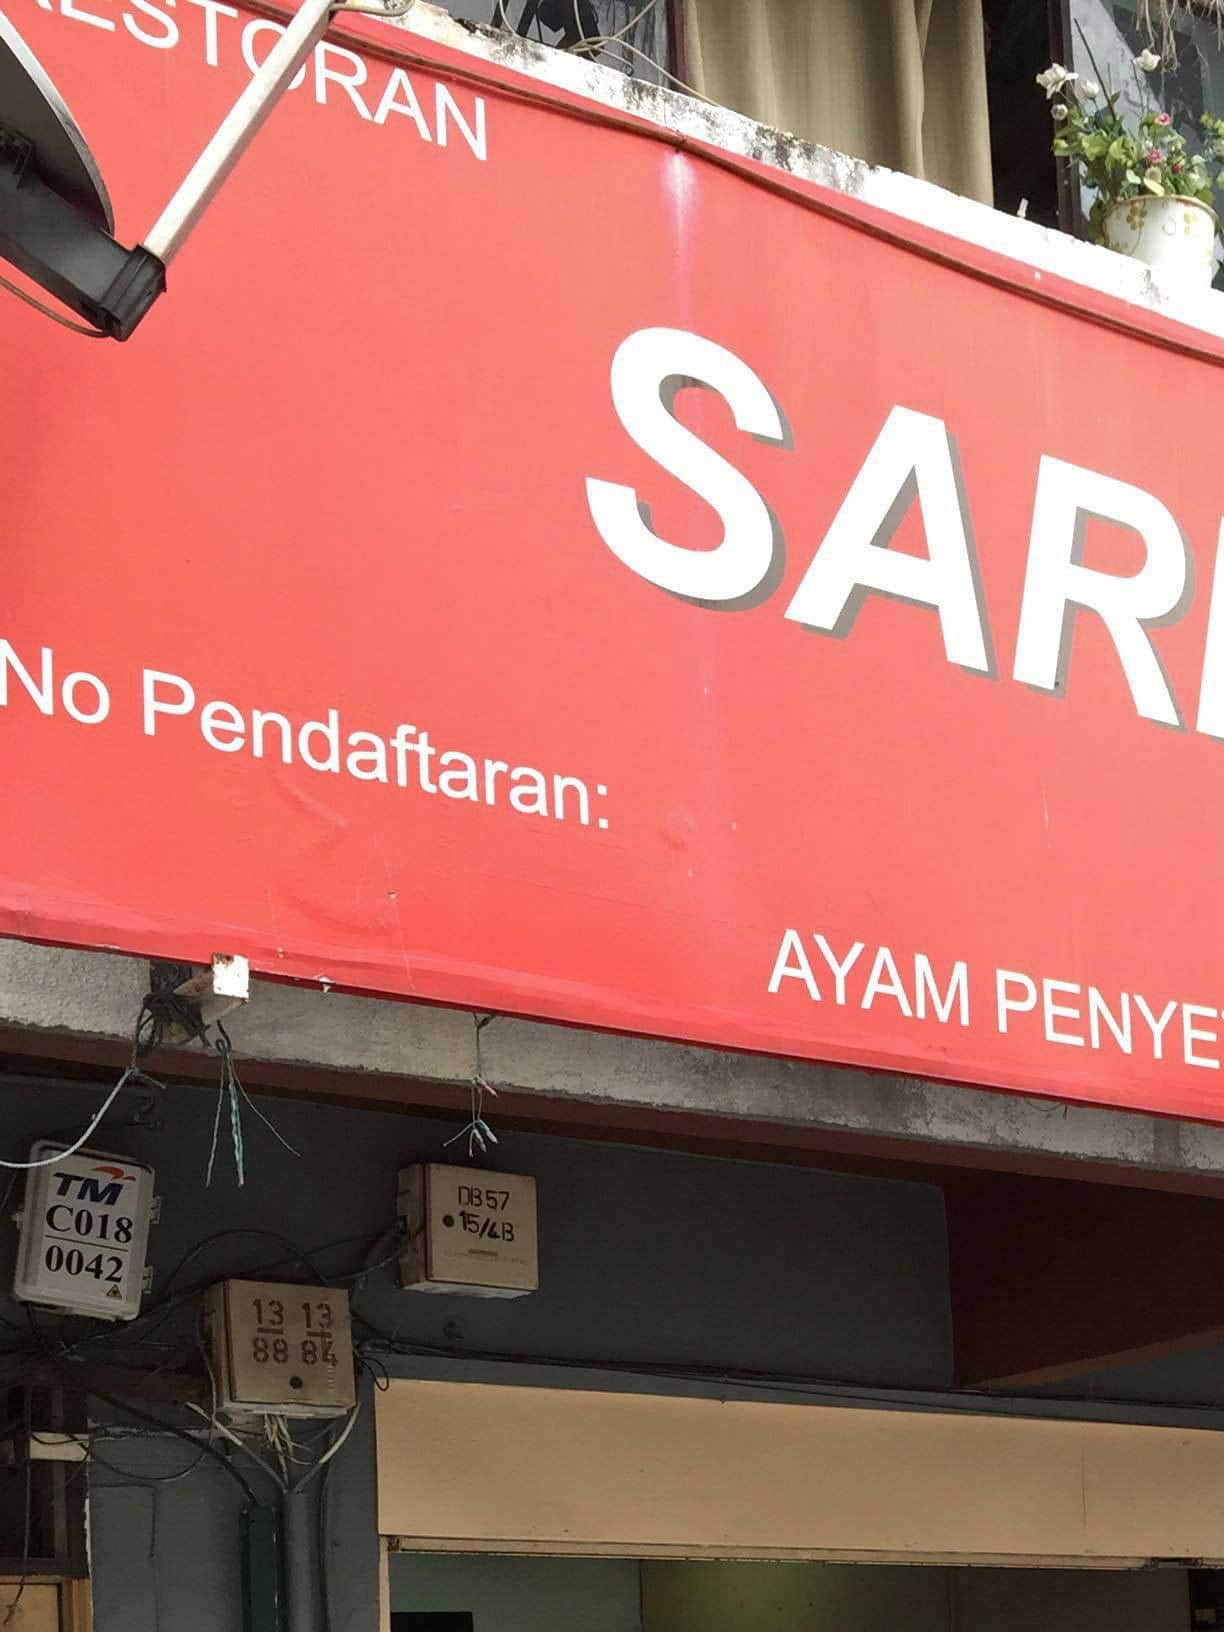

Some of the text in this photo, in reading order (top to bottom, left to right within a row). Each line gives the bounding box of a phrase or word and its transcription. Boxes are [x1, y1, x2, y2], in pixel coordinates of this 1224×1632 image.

[0, 639, 609, 829] No Pendaftaran:
[767, 928, 970, 1026] AYAM
[53, 1172, 124, 1206] TM
[45, 1204, 133, 1244] C018
[45, 1244, 123, 1283] 0042
[252, 1298, 285, 1326] 13
[253, 1337, 288, 1364] 88
